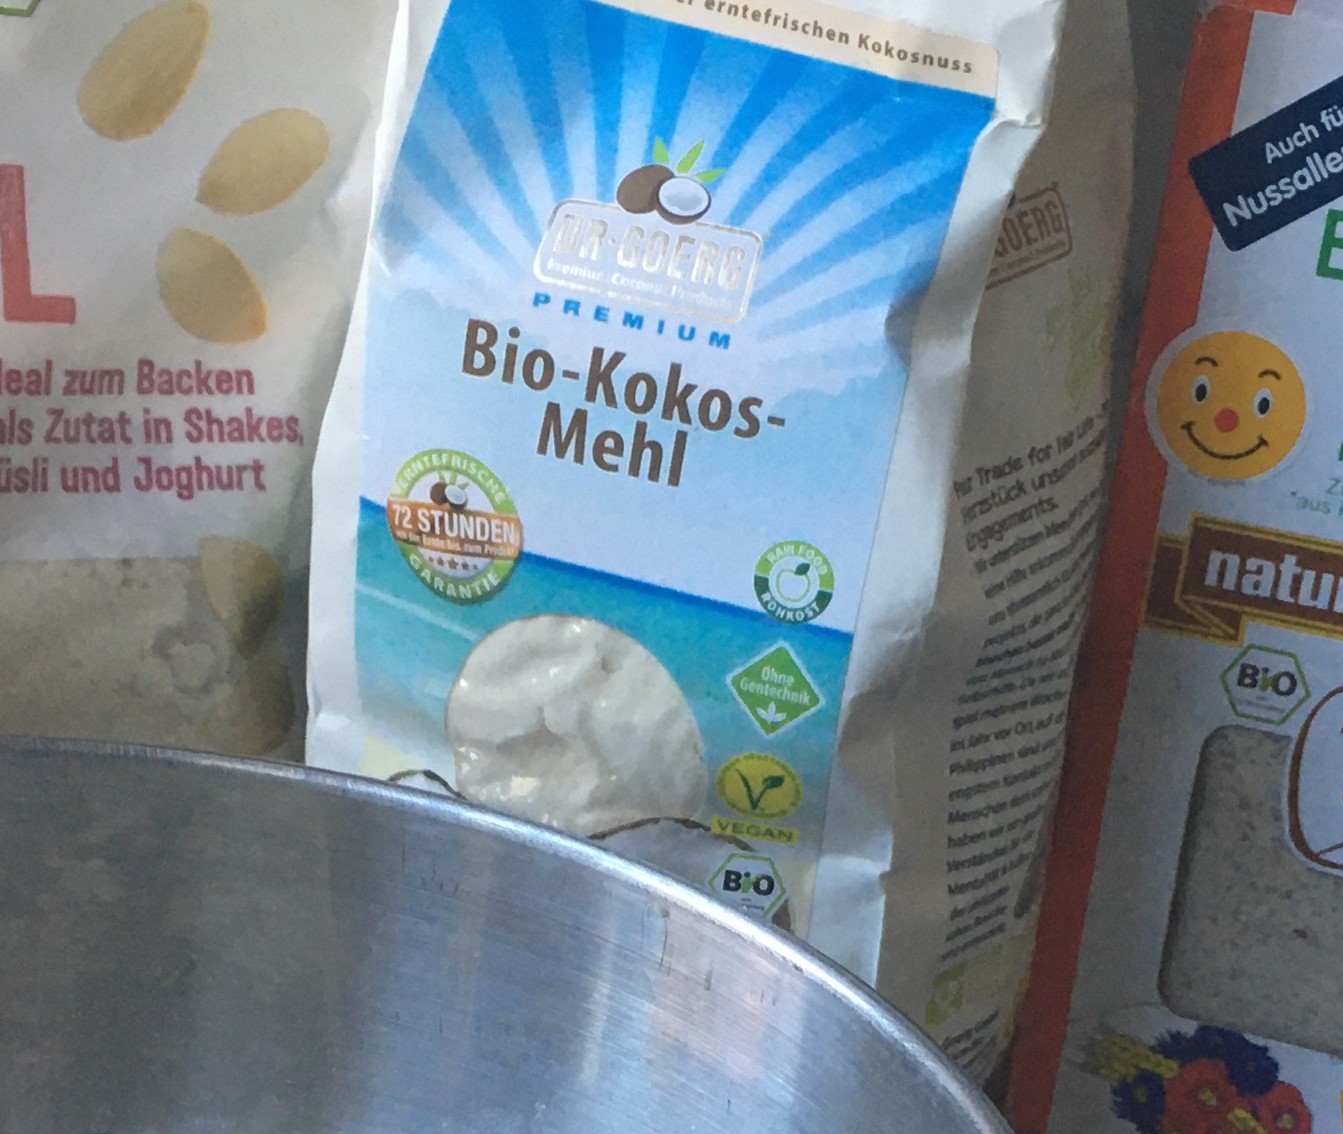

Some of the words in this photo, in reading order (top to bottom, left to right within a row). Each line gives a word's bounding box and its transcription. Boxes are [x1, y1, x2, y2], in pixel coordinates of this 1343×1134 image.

[704, 0, 851, 46] erntefrischen
[858, 33, 974, 74] Kokosnuss
[1265, 122, 1320, 165] Auch
[532, 291, 732, 350] PREMIUM
[61, 366, 125, 396] zum
[136, 358, 256, 396] Backen
[461, 318, 786, 440] Bio-Kokos-
[43, 407, 133, 445] Zutat
[143, 407, 174, 444] in
[183, 407, 304, 447] Shakes,
[537, 401, 689, 488] Mehl
[60, 456, 121, 493] und
[133, 455, 268, 501] Joghurt
[975, 455, 1025, 487] Trade
[1028, 443, 1053, 466] for
[391, 503, 413, 530] 72
[417, 507, 516, 545] STUNDEN
[409, 553, 502, 600] GARANTIE
[760, 591, 820, 622] ROHKOST
[739, 676, 811, 707] Gentechnik
[761, 665, 794, 688] Ohne
[716, 818, 794, 843] VEGAN
